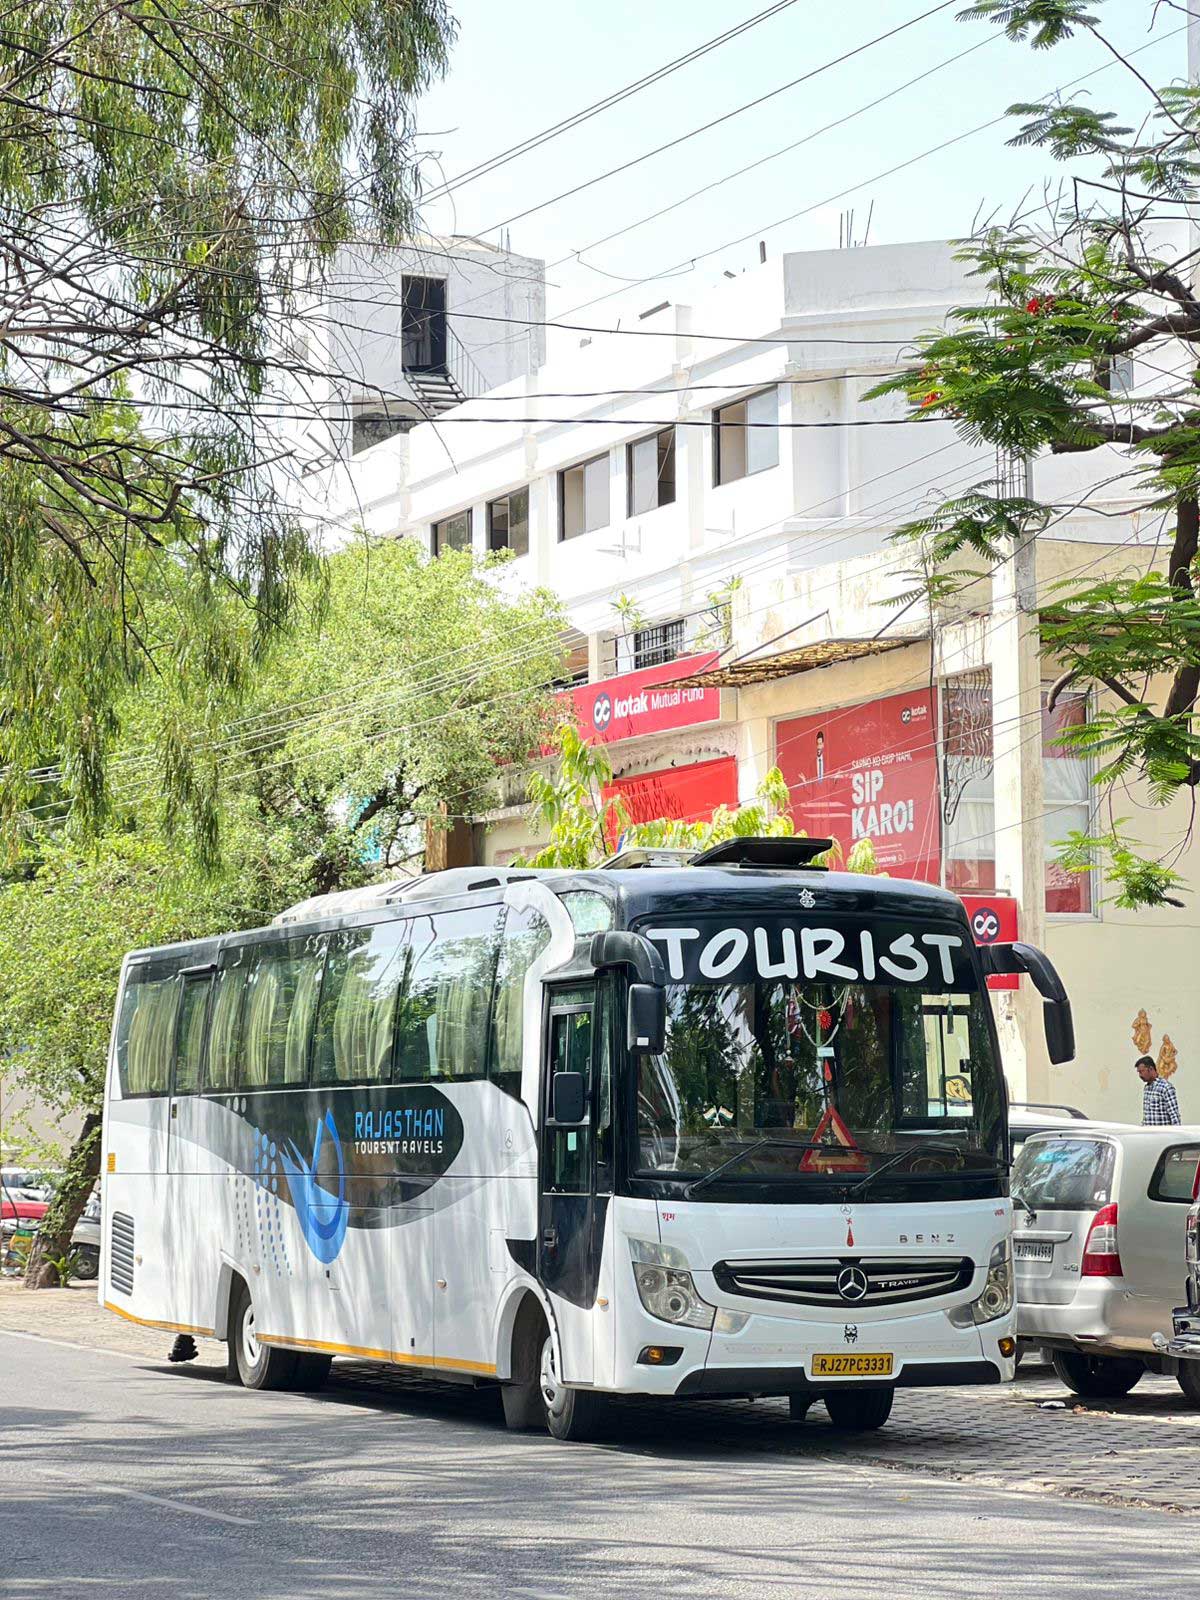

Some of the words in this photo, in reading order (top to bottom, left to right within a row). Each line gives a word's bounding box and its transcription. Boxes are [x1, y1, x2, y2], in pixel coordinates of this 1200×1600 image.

[613, 692, 649, 719] kotak
[651, 689, 681, 710] Mutual
[851, 769, 884, 805] SIP
[851, 799, 915, 840] KARO!
[645, 926, 963, 985] TOURIST
[354, 1108, 444, 1138] RAJASTHAN
[899, 1233, 955, 1244] BENZ
[820, 1357, 891, 1372] RJ27PC3331
